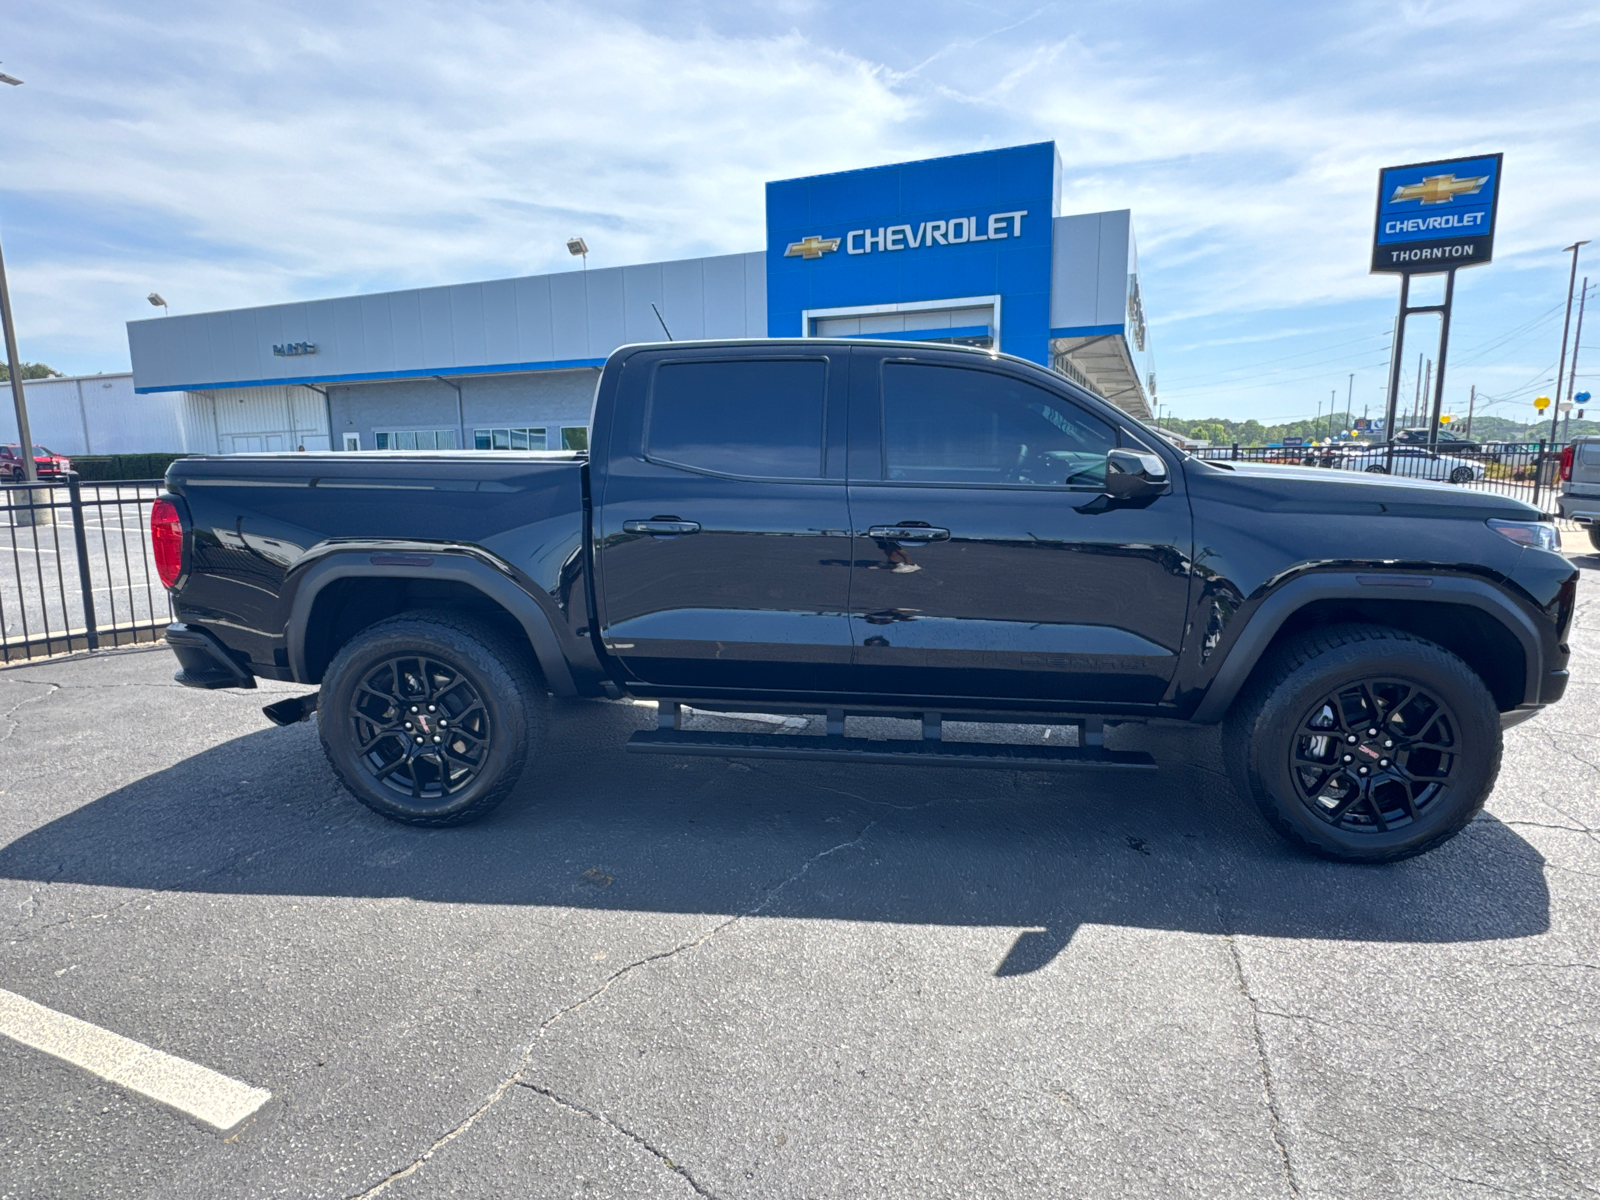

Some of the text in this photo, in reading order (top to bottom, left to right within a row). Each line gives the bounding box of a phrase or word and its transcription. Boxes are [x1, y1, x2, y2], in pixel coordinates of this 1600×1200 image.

[846, 210, 1028, 255] CHEVROLET
[1385, 212, 1485, 234] CHEVROLET
[1391, 244, 1474, 262] THORNTON
[272, 341, 312, 356] PARTS
